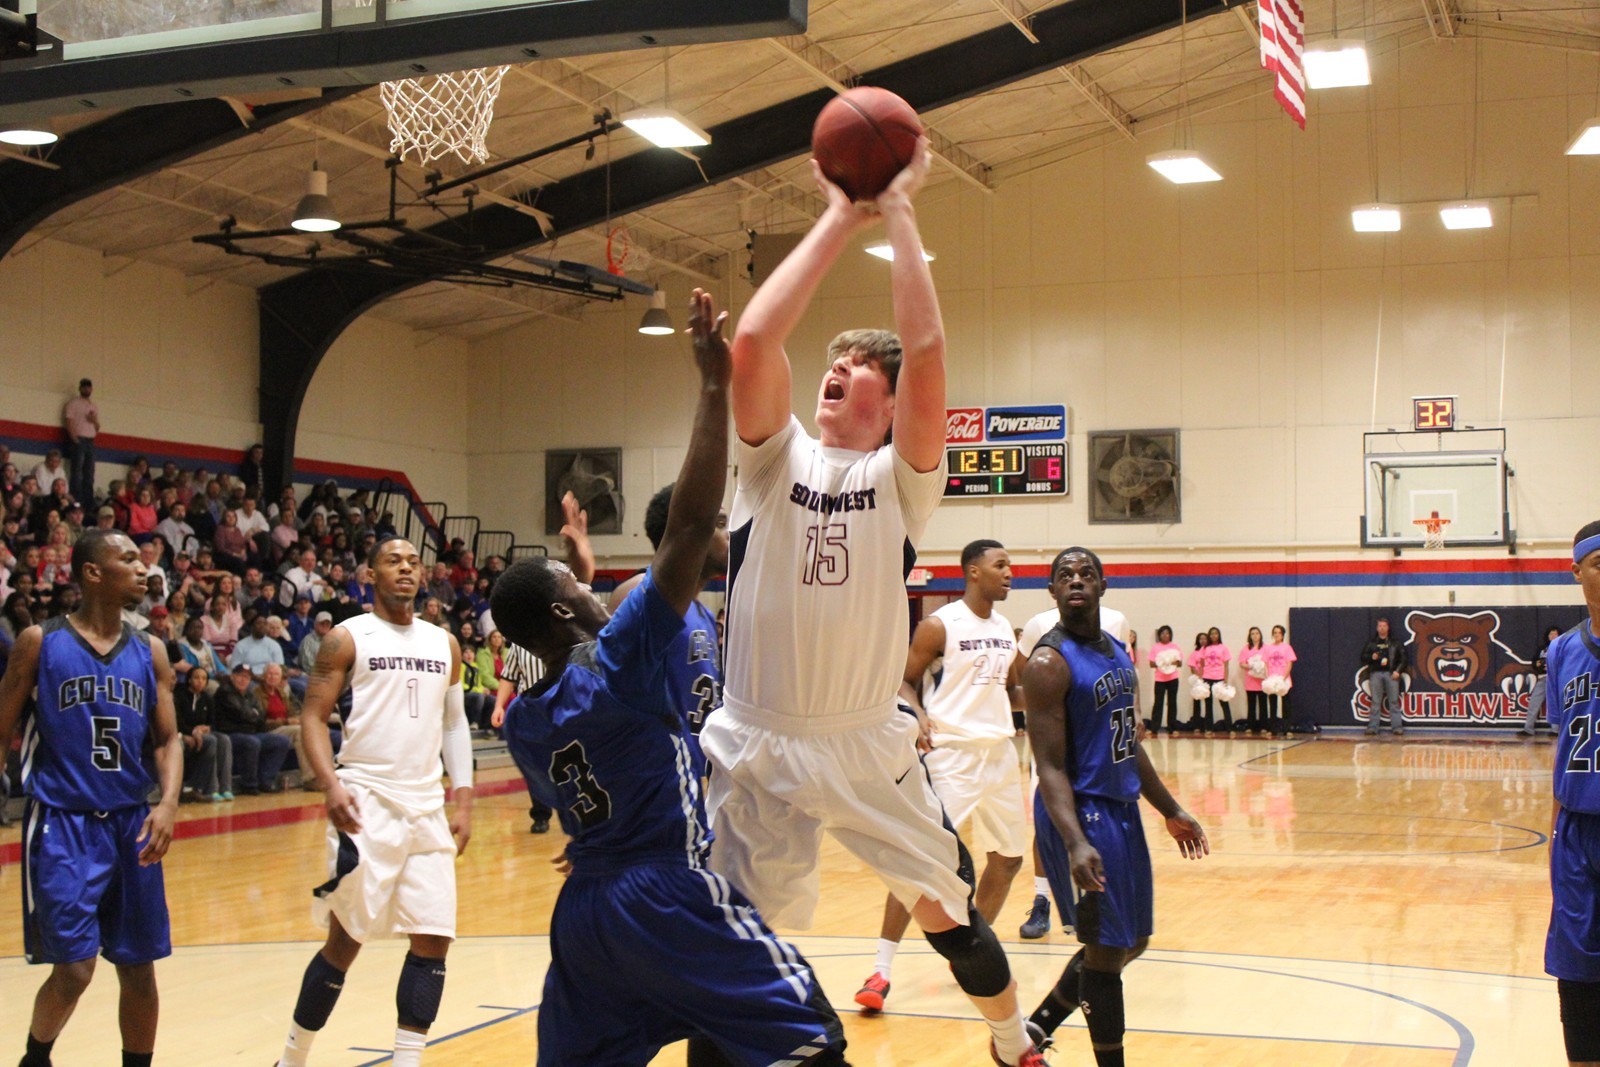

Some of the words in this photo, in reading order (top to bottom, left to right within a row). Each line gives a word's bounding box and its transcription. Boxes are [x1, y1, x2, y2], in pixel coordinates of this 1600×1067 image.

[946, 412, 982, 439] Cola
[1418, 402, 1451, 427] 32
[960, 450, 1018, 473] 12:51
[1026, 446, 1063, 457] VISITOR
[1047, 458, 1061, 480] 6
[965, 484, 989, 493] PERIOD
[1026, 482, 1051, 492] BONUS
[803, 523, 849, 586] 15
[368, 656, 447, 675] SOUTHWEST
[59, 675, 144, 717] CO-LIN
[407, 678, 419, 719] 1
[91, 716, 121, 772] 5
[1110, 706, 1137, 764] 23
[1565, 714, 1600, 773] 2
[548, 739, 612, 829] 3
